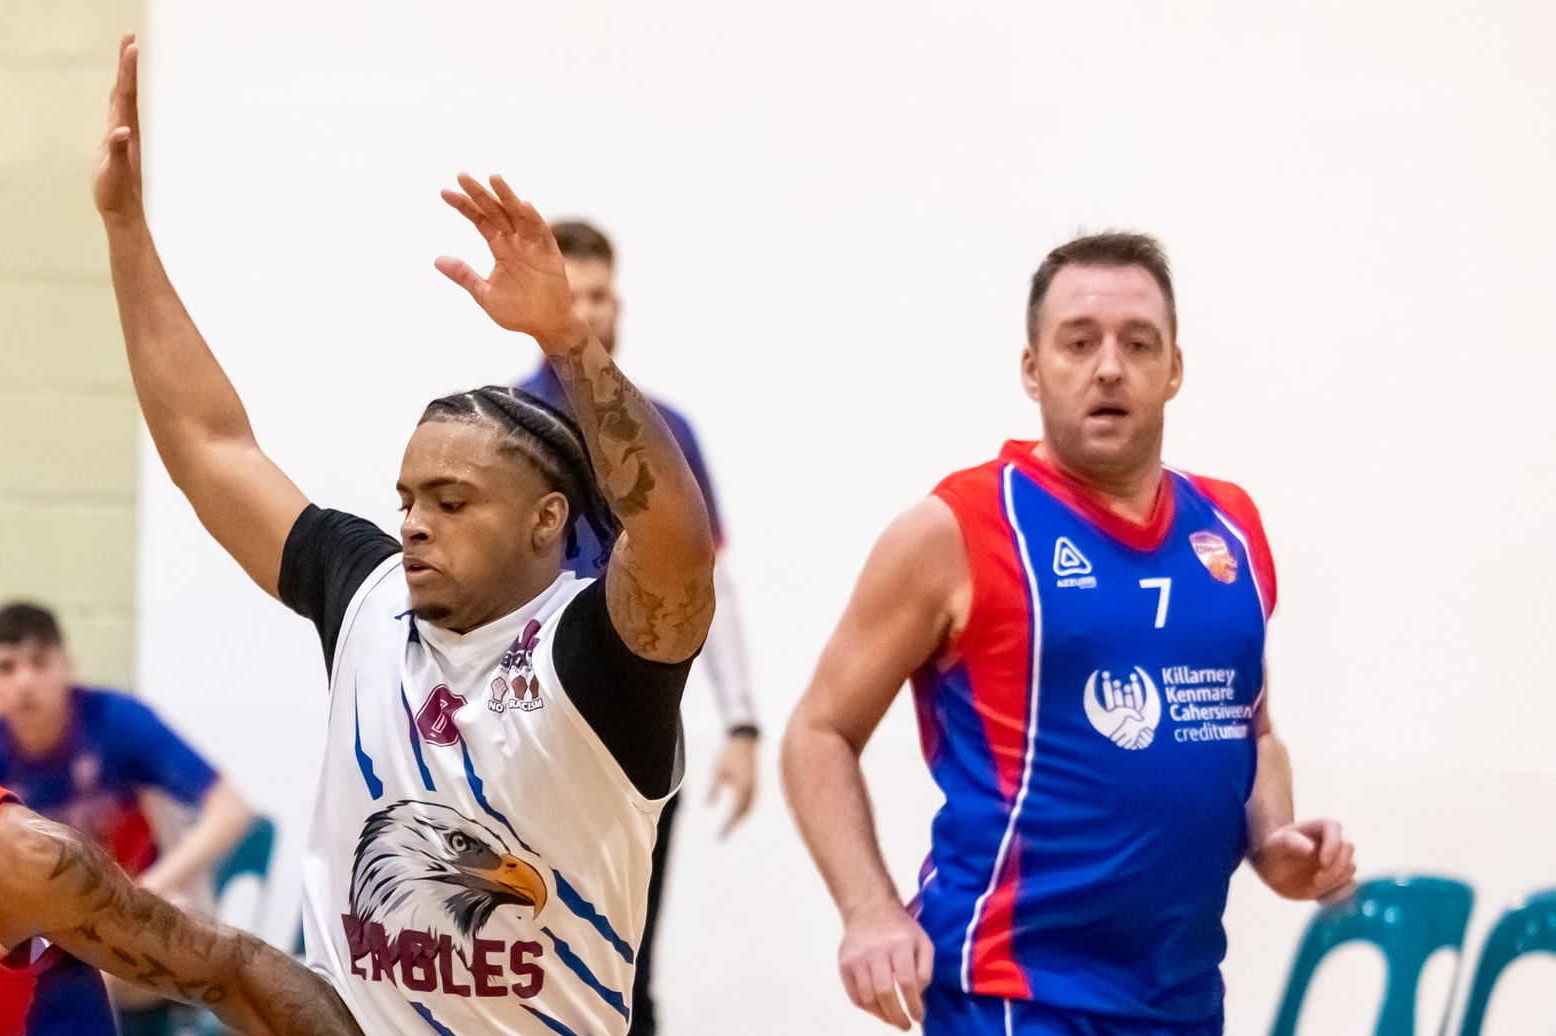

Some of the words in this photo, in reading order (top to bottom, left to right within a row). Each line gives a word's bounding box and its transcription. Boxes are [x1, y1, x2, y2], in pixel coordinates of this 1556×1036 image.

[1139, 578, 1171, 628] 7
[1162, 666, 1235, 687] Killarney
[1165, 686, 1234, 703] Kenmare
[488, 700, 504, 713] NO
[509, 698, 543, 712] RACISM
[1170, 701, 1252, 721] Cahersiveen
